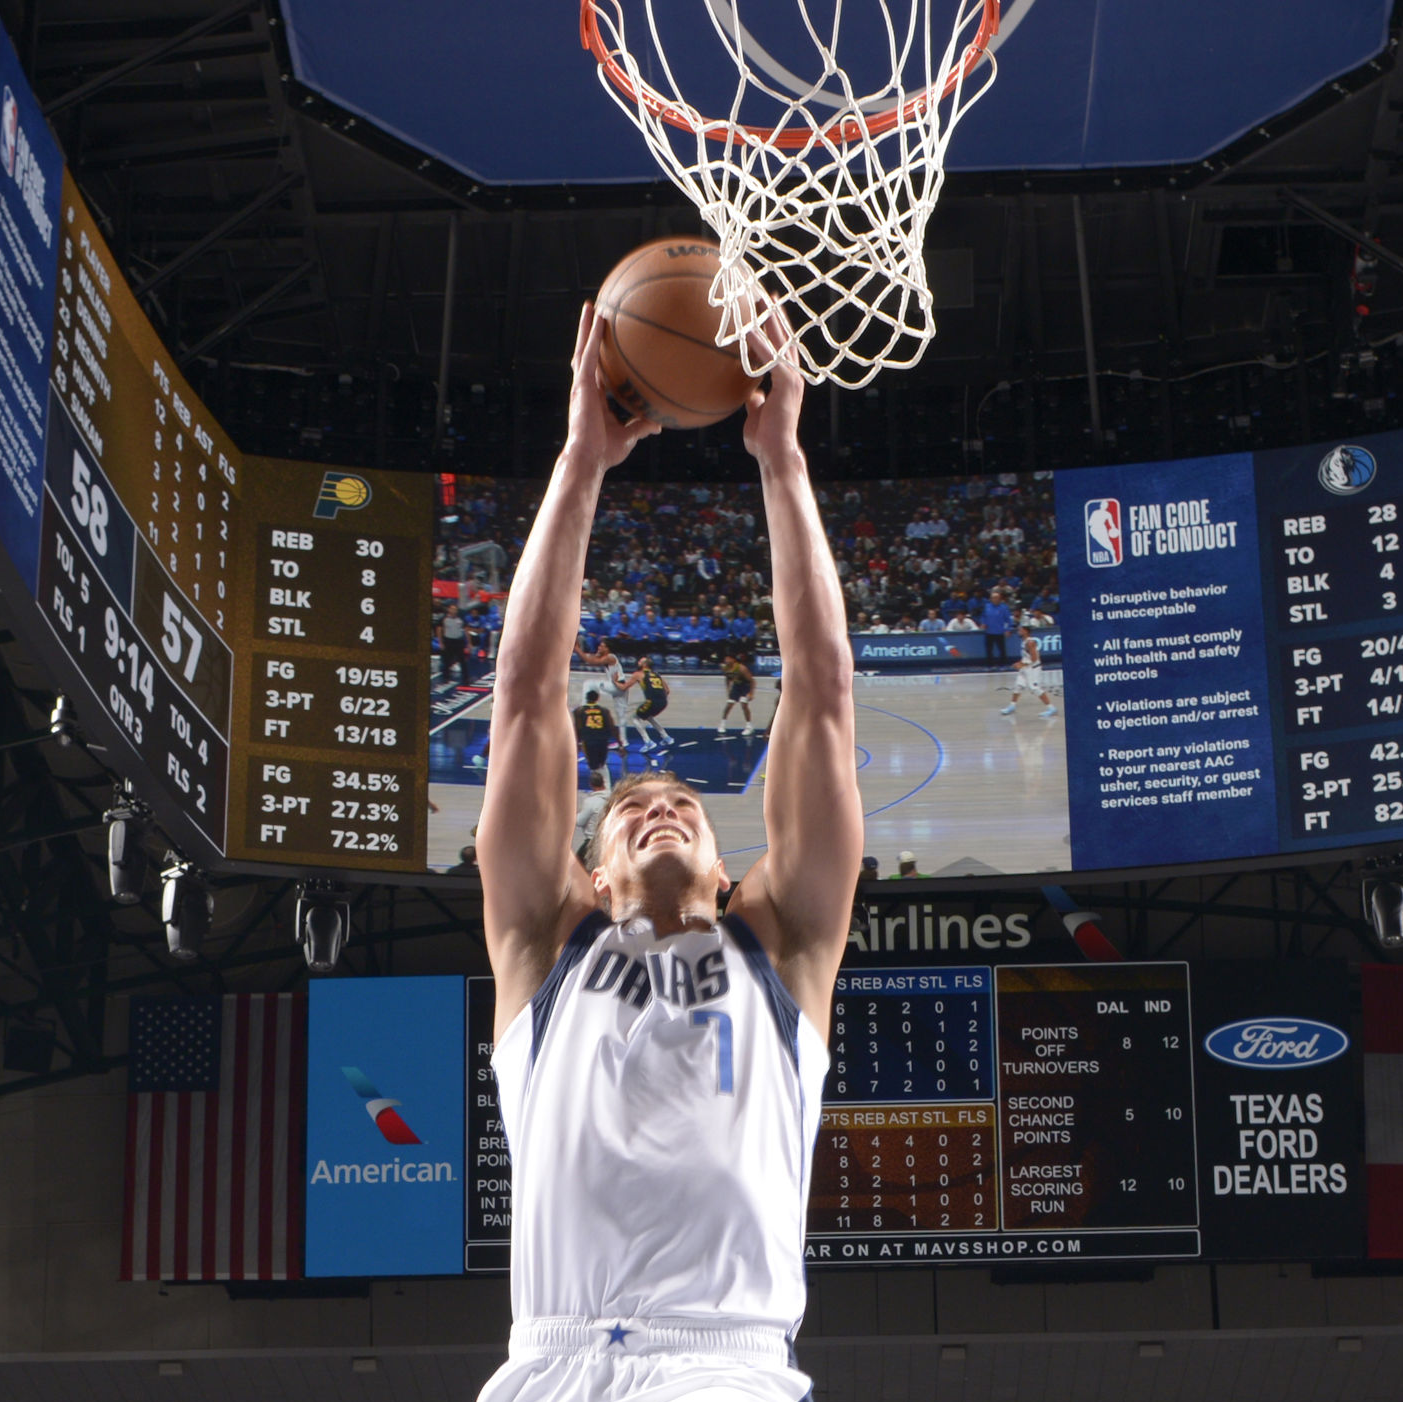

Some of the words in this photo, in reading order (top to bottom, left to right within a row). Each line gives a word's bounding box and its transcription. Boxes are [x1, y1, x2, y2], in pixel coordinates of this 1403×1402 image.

[71, 449, 108, 557] 58
[1129, 504, 1162, 531] FAN
[1165, 499, 1210, 532] CODE
[1284, 515, 1326, 536] REB
[1368, 504, 1397, 524] 28
[272, 530, 313, 550] REB
[356, 539, 384, 558] 30
[1131, 530, 1151, 557] OF
[1155, 518, 1237, 555] CONDUCT
[1285, 546, 1314, 565] TO
[1372, 533, 1399, 552] 12
[270, 559, 299, 578] TO
[361, 569, 376, 586] 8
[1287, 573, 1330, 594] BLK
[1380, 562, 1395, 580] 4
[270, 588, 311, 608] BLK
[360, 598, 375, 615] 6
[1100, 590, 1167, 605] Disruptive
[1170, 584, 1228, 599] behavior
[1092, 610, 1104, 621] is
[1107, 602, 1196, 620] unacceptable
[1289, 603, 1328, 623] STL
[1382, 592, 1397, 610] 3
[161, 591, 202, 683] 57
[268, 616, 306, 636] STL
[360, 626, 374, 643] 4
[1102, 638, 1120, 651] All
[1123, 637, 1153, 649] fans
[1156, 634, 1190, 647] must
[1193, 628, 1242, 643] comply
[105, 607, 154, 712] 9:14
[861, 644, 938, 661] American
[1094, 654, 1123, 667] with
[1125, 650, 1168, 664] health
[1170, 647, 1196, 661] and
[1198, 644, 1240, 662] safety
[1293, 648, 1322, 667] FG
[267, 660, 295, 679] FG
[336, 666, 398, 688] 19/55
[1095, 667, 1158, 685] protocols
[1295, 674, 1343, 696] 3-PT
[265, 690, 314, 710] 3-PT
[340, 696, 390, 716] 6/22
[1105, 698, 1173, 713] Violations
[1176, 697, 1198, 707] are
[1201, 690, 1250, 709] subject
[1097, 719, 1111, 730] to
[1114, 714, 1168, 730] ejection
[1171, 710, 1216, 724] and/or
[1218, 705, 1259, 719] arrest
[1297, 706, 1323, 725] FT
[265, 719, 290, 738] FT
[334, 724, 396, 746] 13/18
[1108, 747, 1154, 762] Report
[1156, 746, 1181, 758] any
[1184, 739, 1250, 754] violations
[1300, 751, 1329, 771] FG
[263, 764, 291, 784] FG
[332, 770, 400, 792] 34.5%
[1099, 766, 1114, 777] to
[1116, 764, 1146, 778] your
[1150, 758, 1201, 773] nearest
[1204, 754, 1234, 768] AAC
[1100, 780, 1141, 792] usher,
[1144, 774, 1201, 789] security,
[1204, 774, 1219, 784] or
[1222, 768, 1260, 785] guest
[1302, 778, 1351, 800] 3-PT
[261, 794, 310, 815] 3-PT
[331, 800, 399, 822] 27.3%
[1101, 795, 1158, 809] services
[1161, 790, 1193, 804] staff
[1196, 786, 1253, 801] member
[1304, 811, 1330, 830] FT
[260, 824, 286, 843] FT
[331, 830, 398, 852] 72.2%
[1097, 1001, 1129, 1014] DAL
[1144, 1000, 1171, 1013] IND
[1022, 1026, 1078, 1040] POINTS
[1233, 1025, 1320, 1059] Ford
[689, 1011, 734, 1096] 7
[1035, 1044, 1066, 1057] OFF
[1122, 1037, 1132, 1050] 8
[1162, 1036, 1179, 1049] 12
[1002, 1060, 1100, 1075] TURNOVERS
[1008, 1096, 1074, 1110] SECOND
[1230, 1093, 1324, 1124] TEXAS
[1008, 1113, 1074, 1127] CHANCE
[1125, 1108, 1134, 1121] 5
[1165, 1107, 1182, 1120] 10
[1014, 1130, 1071, 1144] POINTS
[1239, 1129, 1318, 1159] FORD
[310, 1157, 452, 1184] American
[1010, 1165, 1082, 1179] LARGEST
[1214, 1163, 1347, 1195] DEALERS
[1011, 1182, 1083, 1196] SCORING
[1120, 1178, 1136, 1192] 12
[1168, 1178, 1185, 1190] 10
[1031, 1200, 1064, 1213] RUN
[842, 1244, 869, 1257] ON
[880, 1243, 904, 1256] AT
[914, 1240, 1080, 1255] MAVSSHOP.COM
